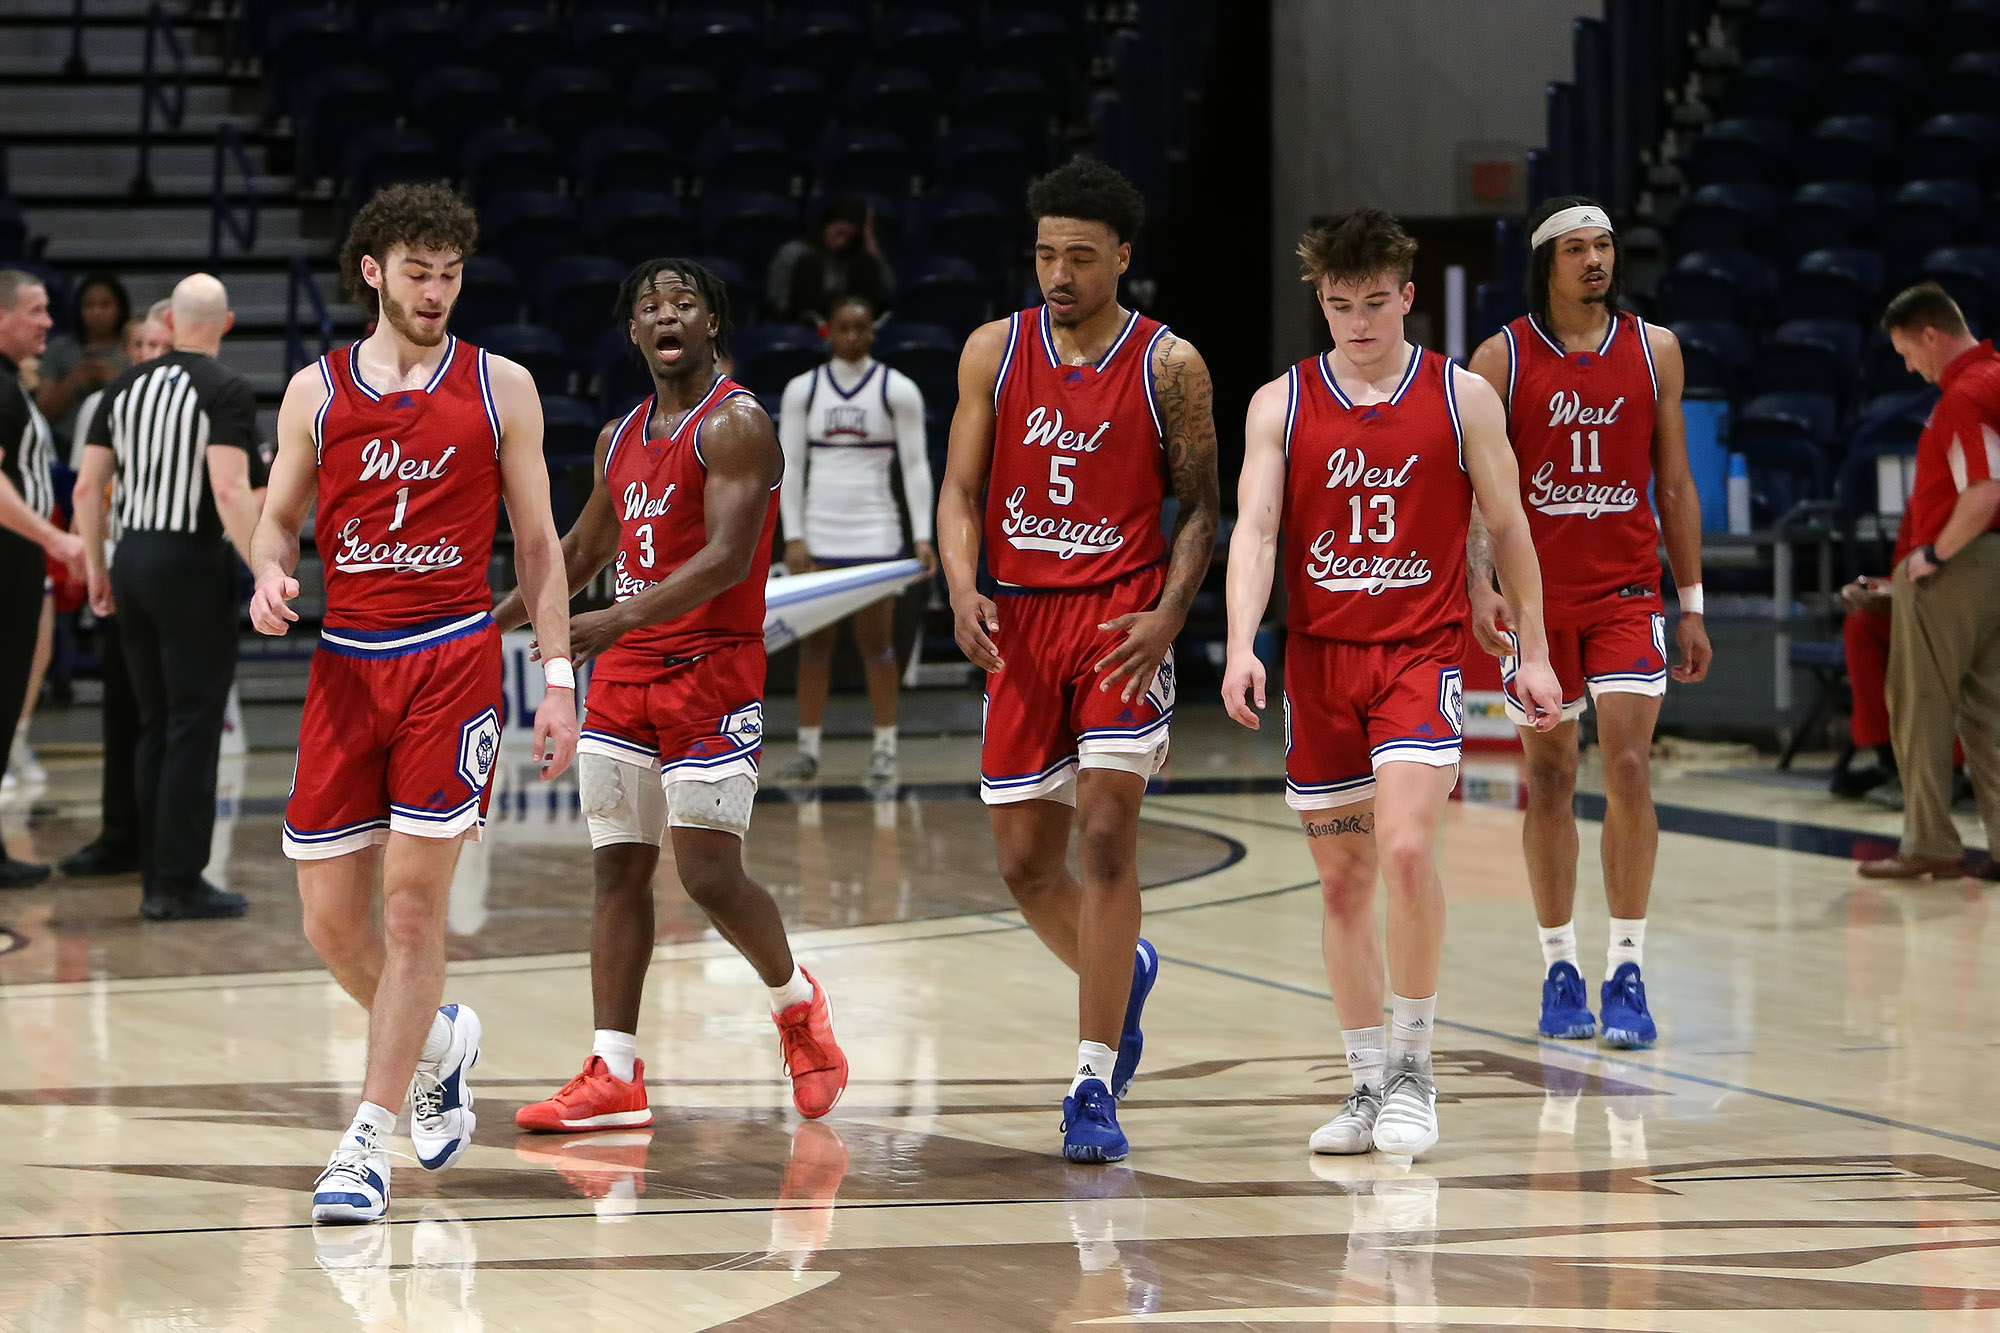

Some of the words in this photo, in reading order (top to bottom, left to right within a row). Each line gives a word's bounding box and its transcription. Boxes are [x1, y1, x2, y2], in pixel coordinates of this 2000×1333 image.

[1022, 406, 1111, 452] West
[1547, 390, 1625, 427] West
[359, 438, 457, 482] West
[1325, 447, 1419, 489] West
[1570, 430, 1602, 473] 11
[1048, 454, 1078, 506] 5
[1528, 461, 1639, 521] Georgia
[387, 486, 410, 532] 1
[1001, 485, 1125, 561] Georgia
[1348, 494, 1396, 544] 13
[334, 517, 464, 574] Georgia
[634, 523, 656, 569] 3
[1306, 529, 1432, 596] Georgia
